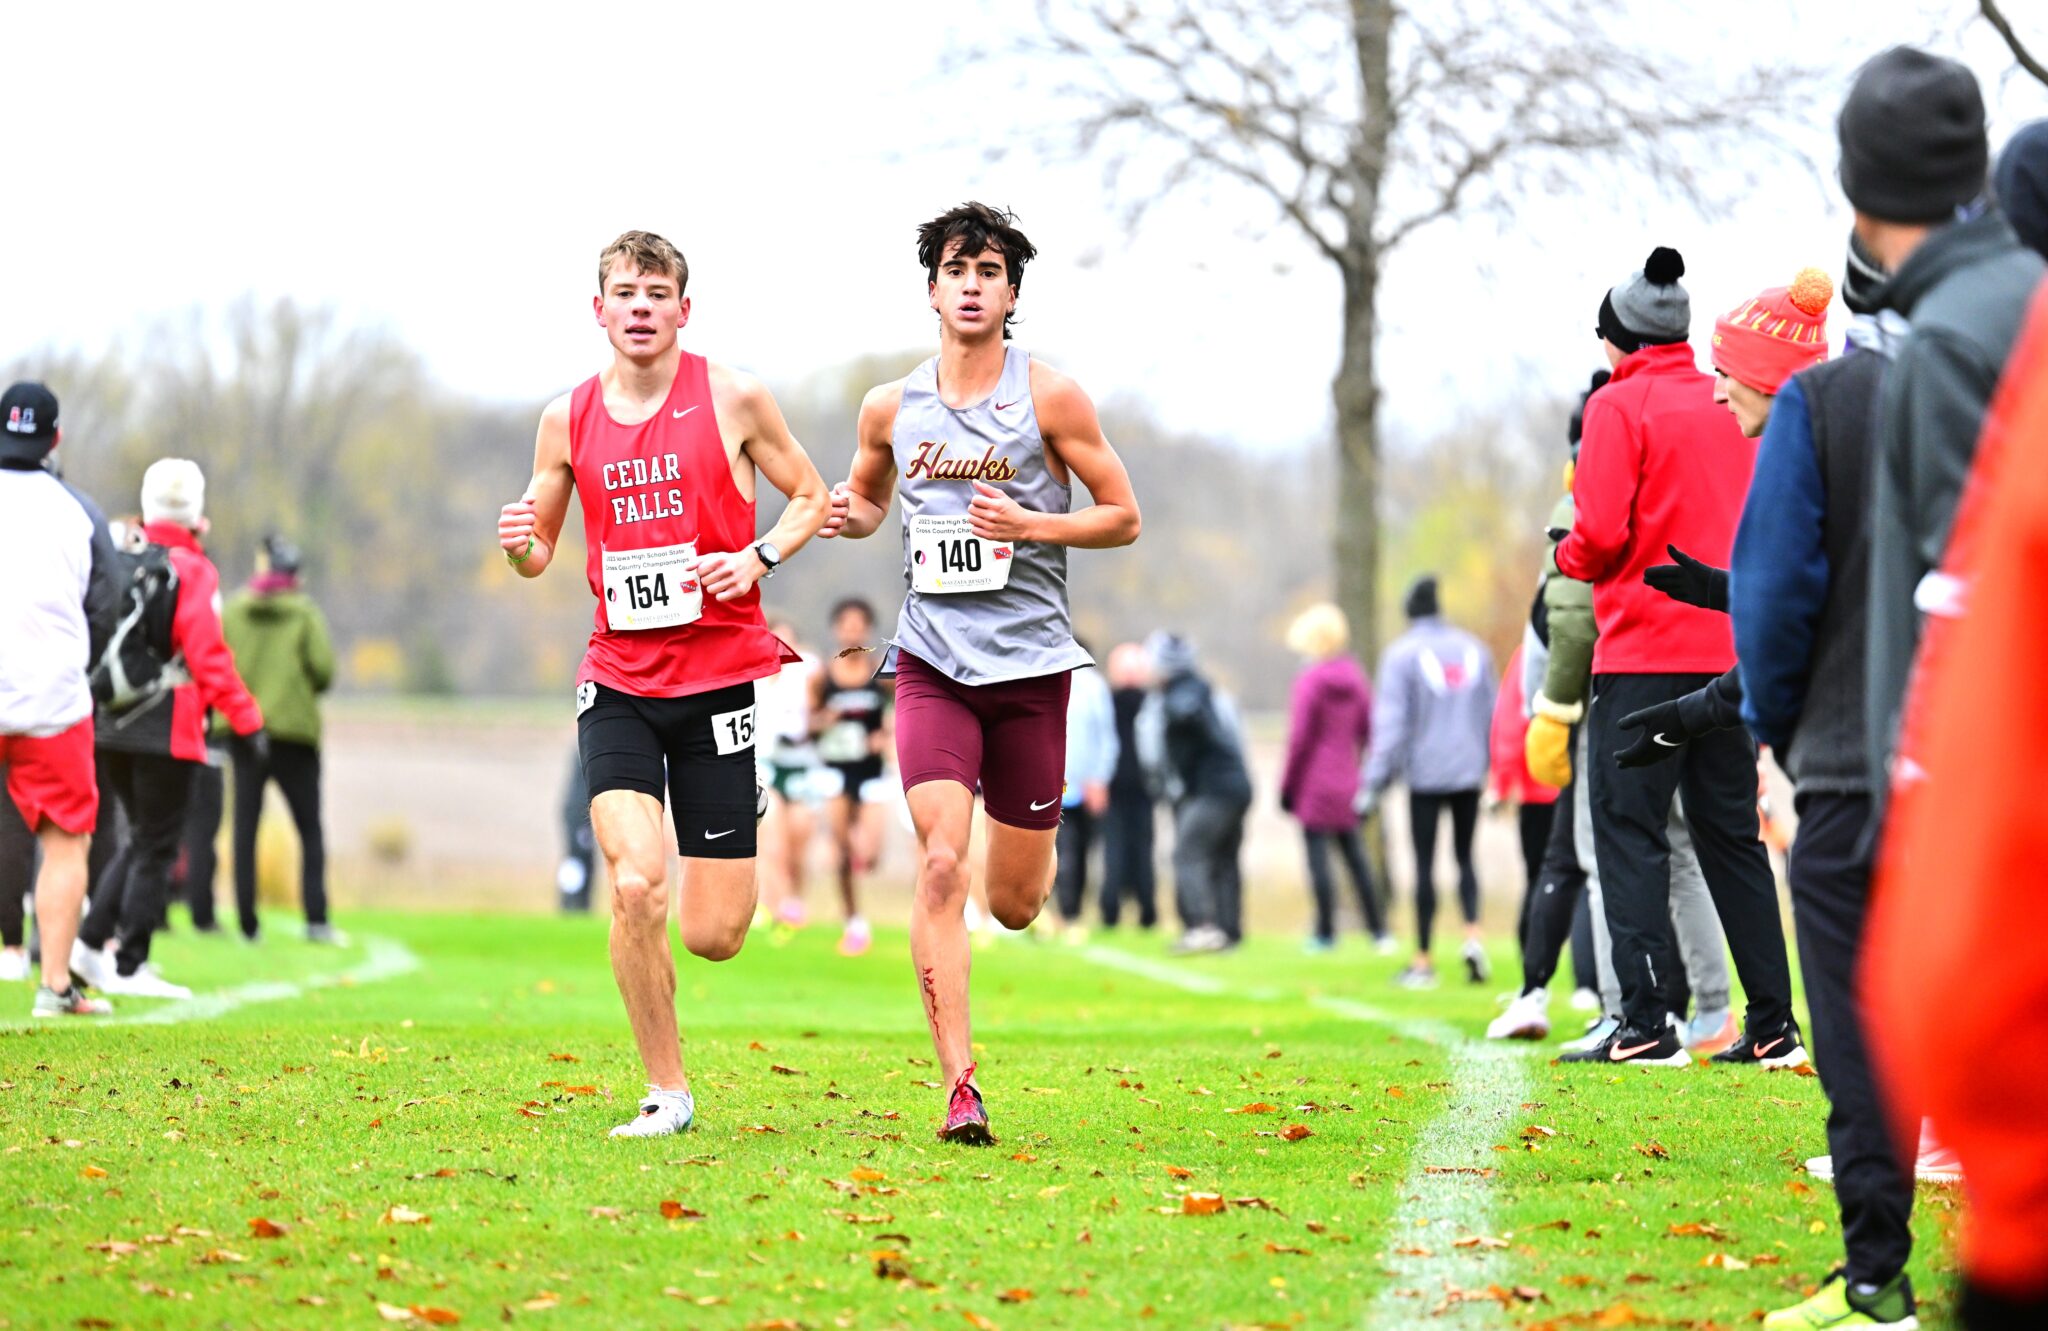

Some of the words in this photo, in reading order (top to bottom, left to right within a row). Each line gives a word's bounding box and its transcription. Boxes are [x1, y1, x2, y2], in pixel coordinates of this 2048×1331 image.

[603, 453, 681, 490] CEDAR
[905, 441, 1017, 482] Hawks
[611, 488, 684, 525] FALLS
[932, 527, 956, 535] Country
[618, 563, 641, 571] Country
[642, 557, 690, 568] Championships
[631, 553, 646, 561] High
[647, 550, 668, 559] School
[669, 548, 685, 556] State
[937, 538, 982, 573] 140
[624, 573, 670, 610] 154
